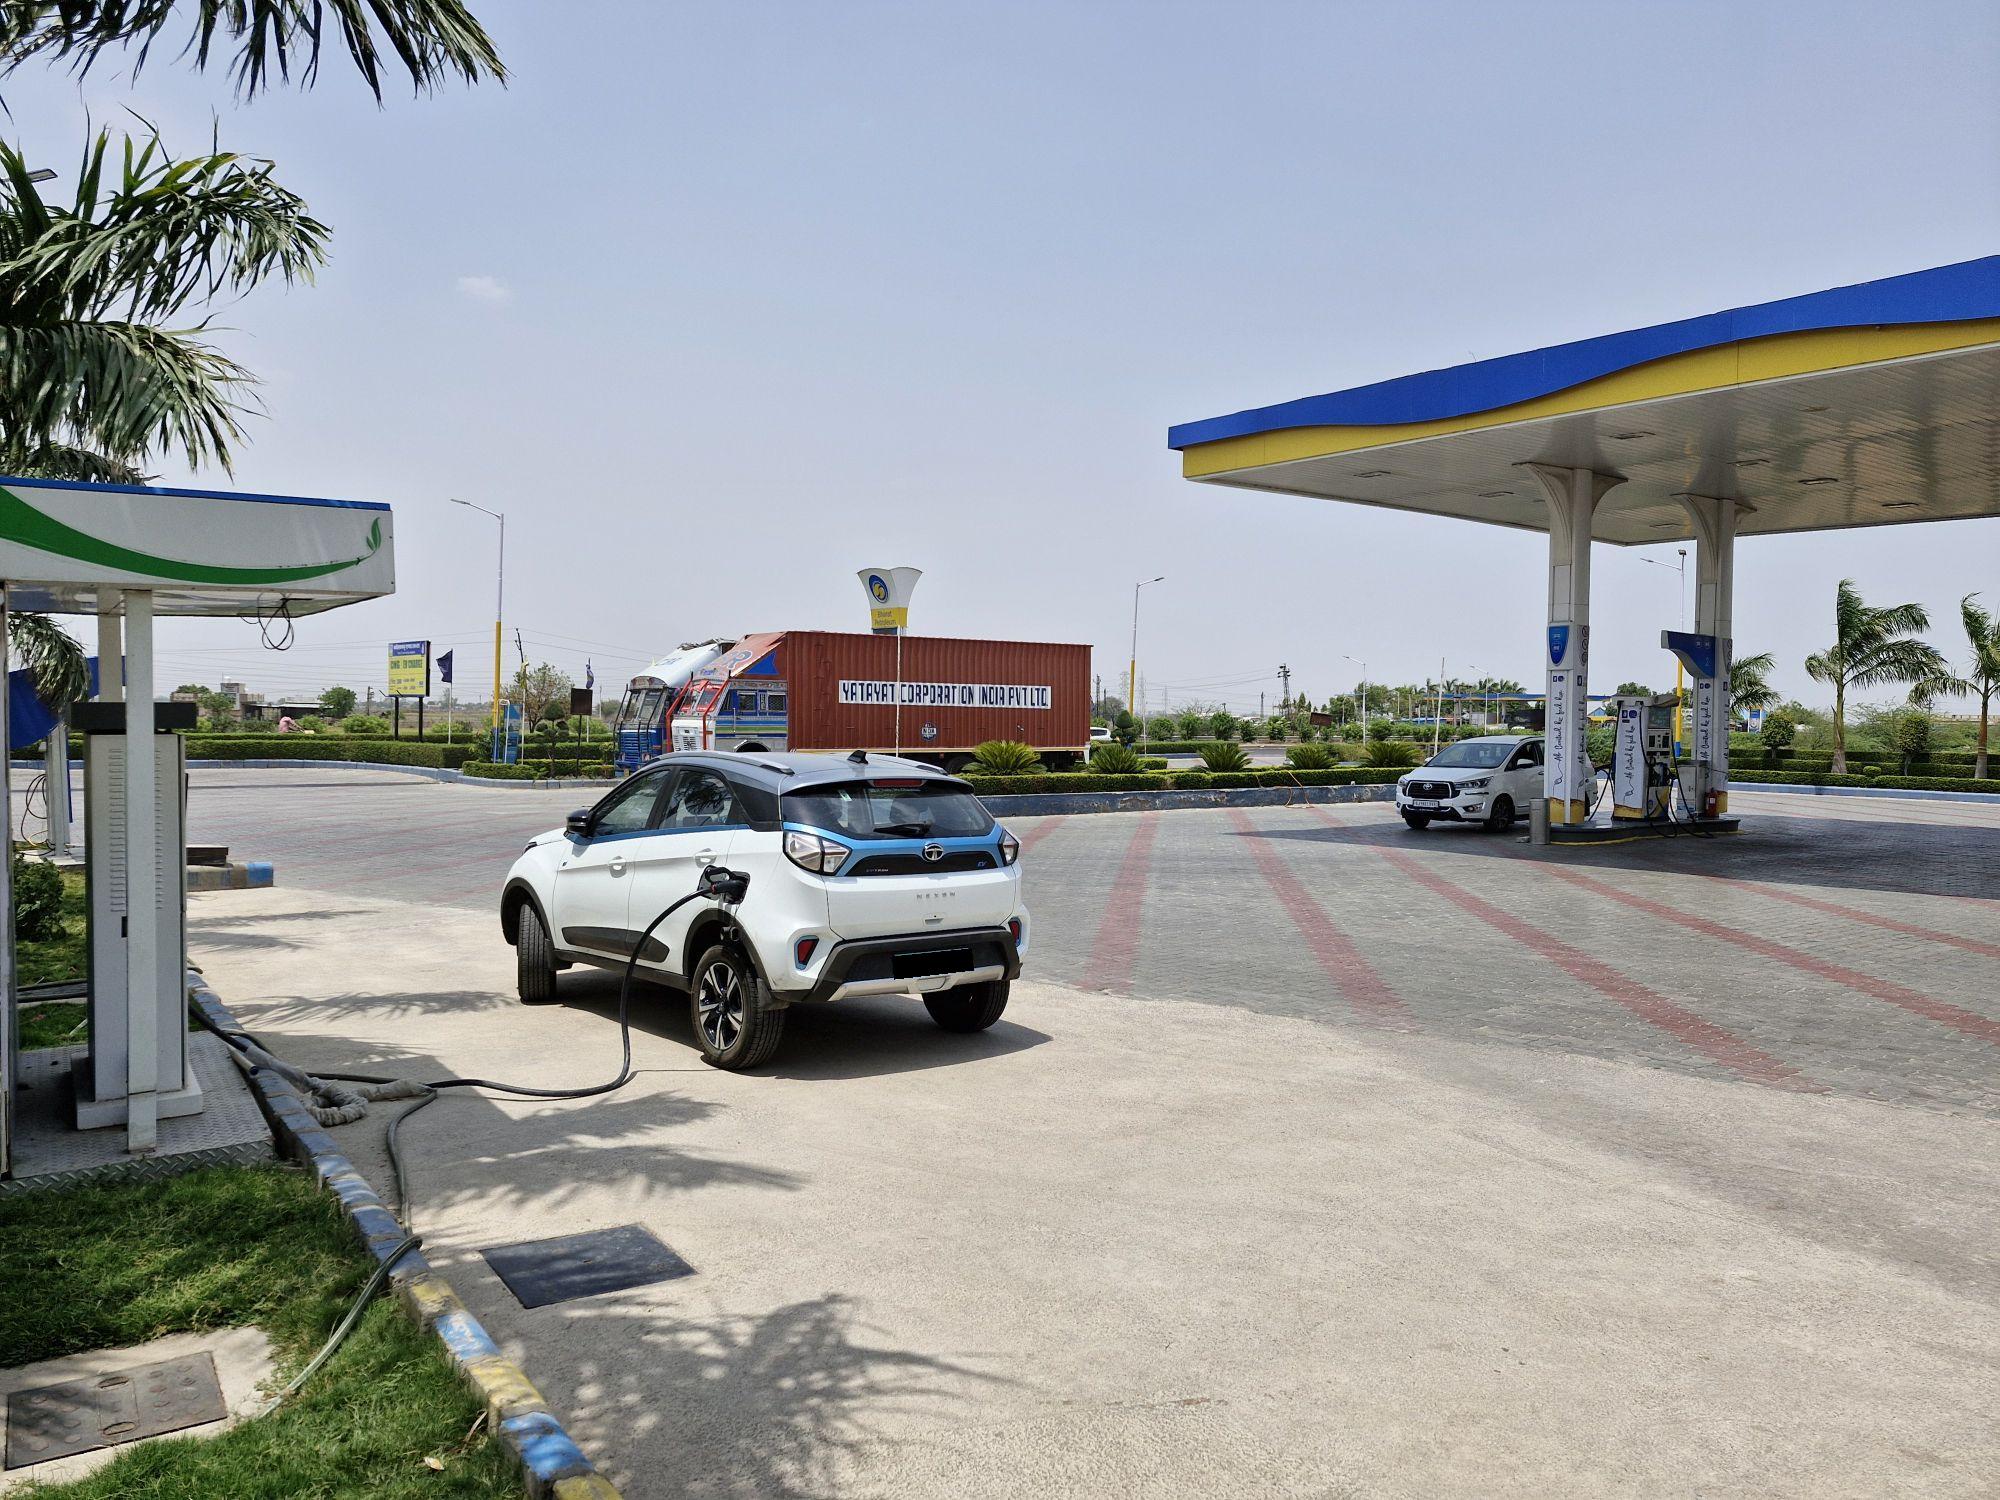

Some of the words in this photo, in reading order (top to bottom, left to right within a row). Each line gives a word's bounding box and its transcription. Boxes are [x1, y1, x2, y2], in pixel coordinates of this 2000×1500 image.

[842, 682, 895, 703] YATAYAT
[900, 683, 974, 705] CORPORATION
[979, 686, 1005, 706] INDIA
[1008, 686, 1027, 706] PVT
[1555, 727, 1563, 750] Control
[916, 891, 956, 900] NEXON
